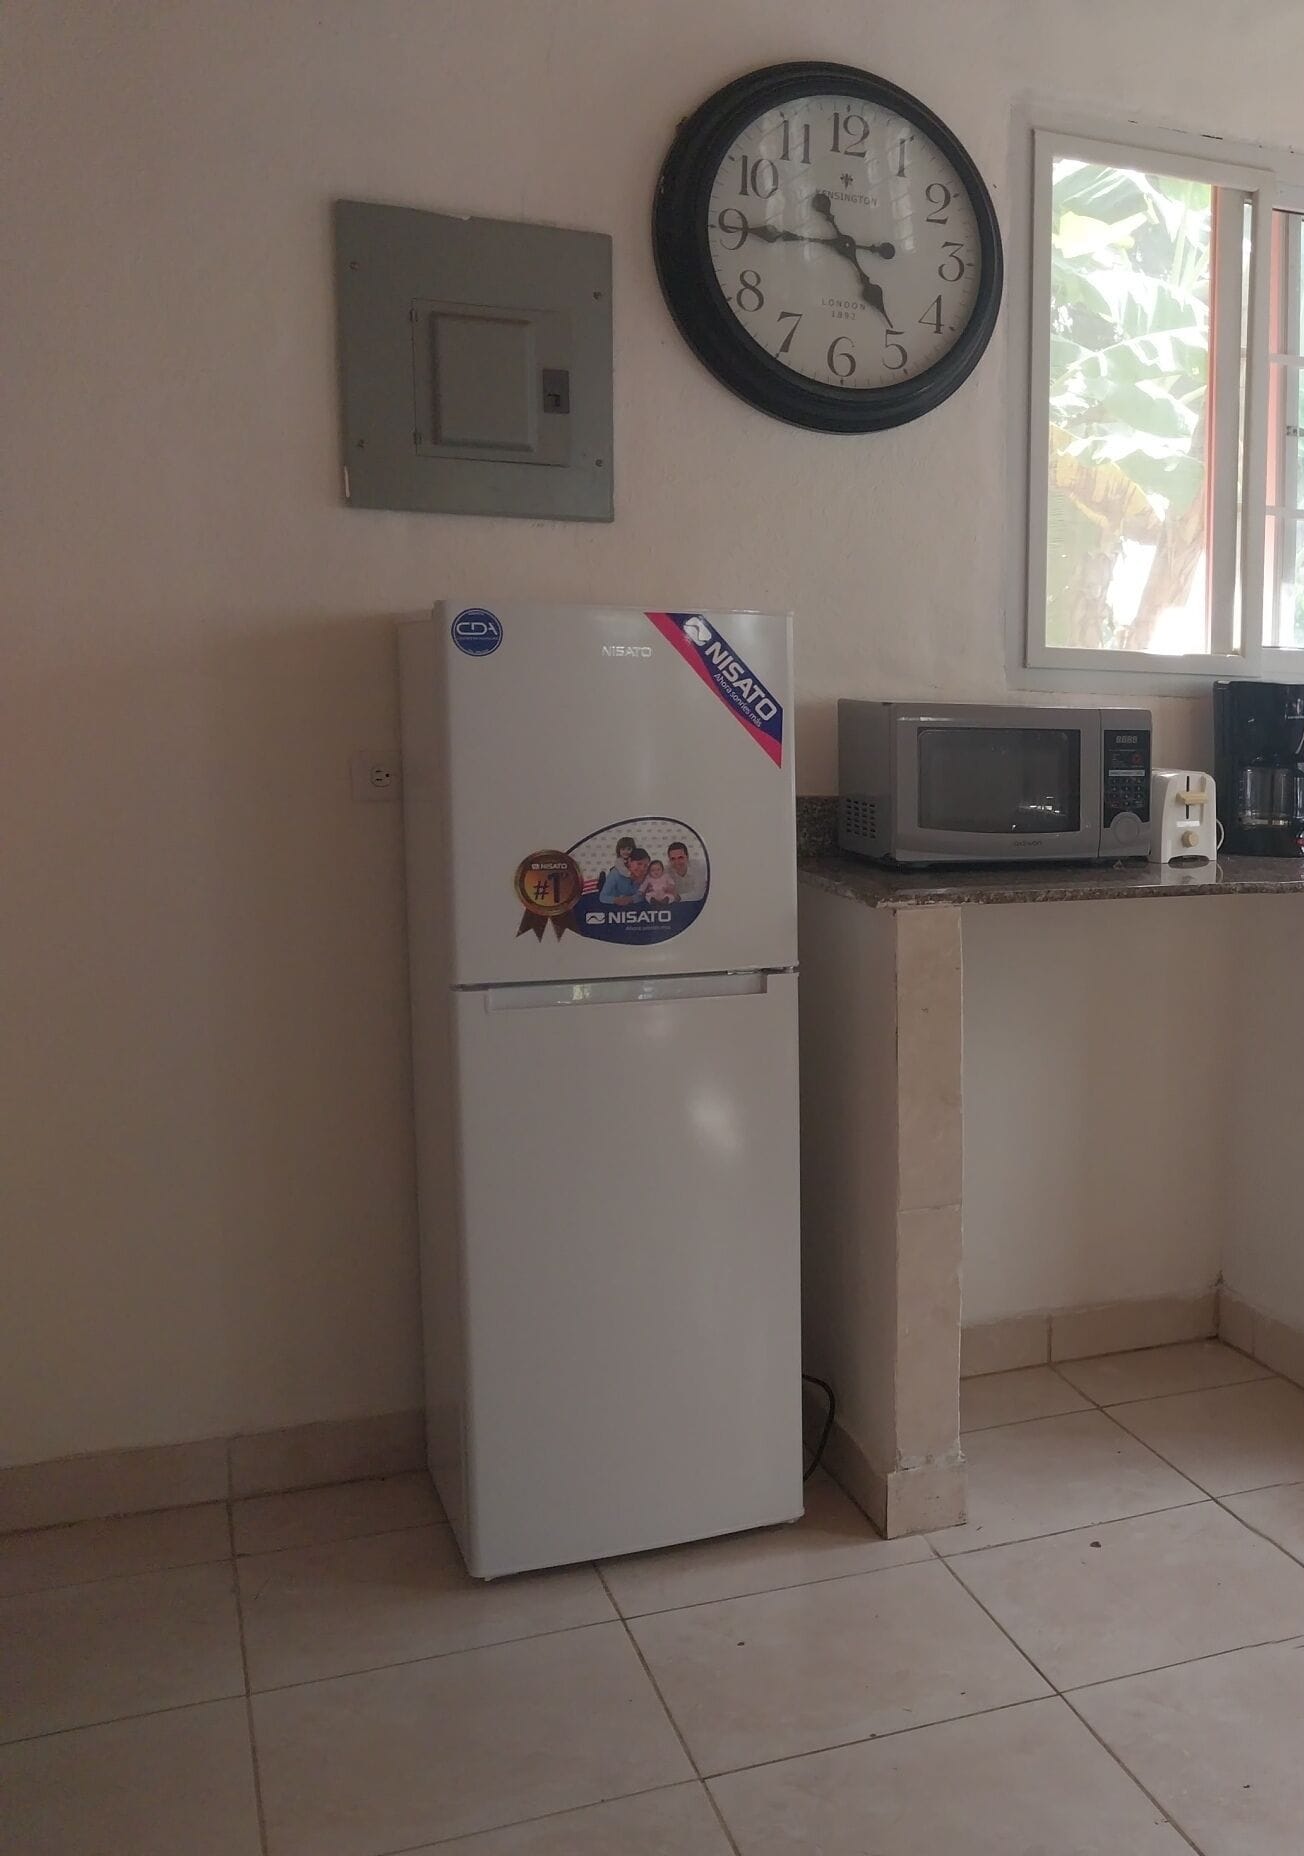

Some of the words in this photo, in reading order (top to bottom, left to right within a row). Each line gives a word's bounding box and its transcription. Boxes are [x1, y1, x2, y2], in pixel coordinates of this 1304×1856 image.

[779, 119, 811, 164] 11
[829, 112, 870, 158] 12
[738, 154, 779, 200] 10
[895, 135, 915, 178] 1
[925, 183, 951, 225] 2
[718, 208, 749, 251] 9
[938, 241, 965, 282] 3
[736, 269, 765, 312] 8
[821, 297, 866, 310] LONDON
[777, 311, 803, 353] 7
[918, 294, 945, 335] 4
[827, 336, 857, 378] 6
[882, 328, 908, 370] 5
[456, 621, 498, 636] CDA
[601, 645, 652, 657] NISATO
[704, 641, 777, 721] NISATO
[714, 673, 733, 694] Ahora
[608, 910, 672, 924] NISATO
